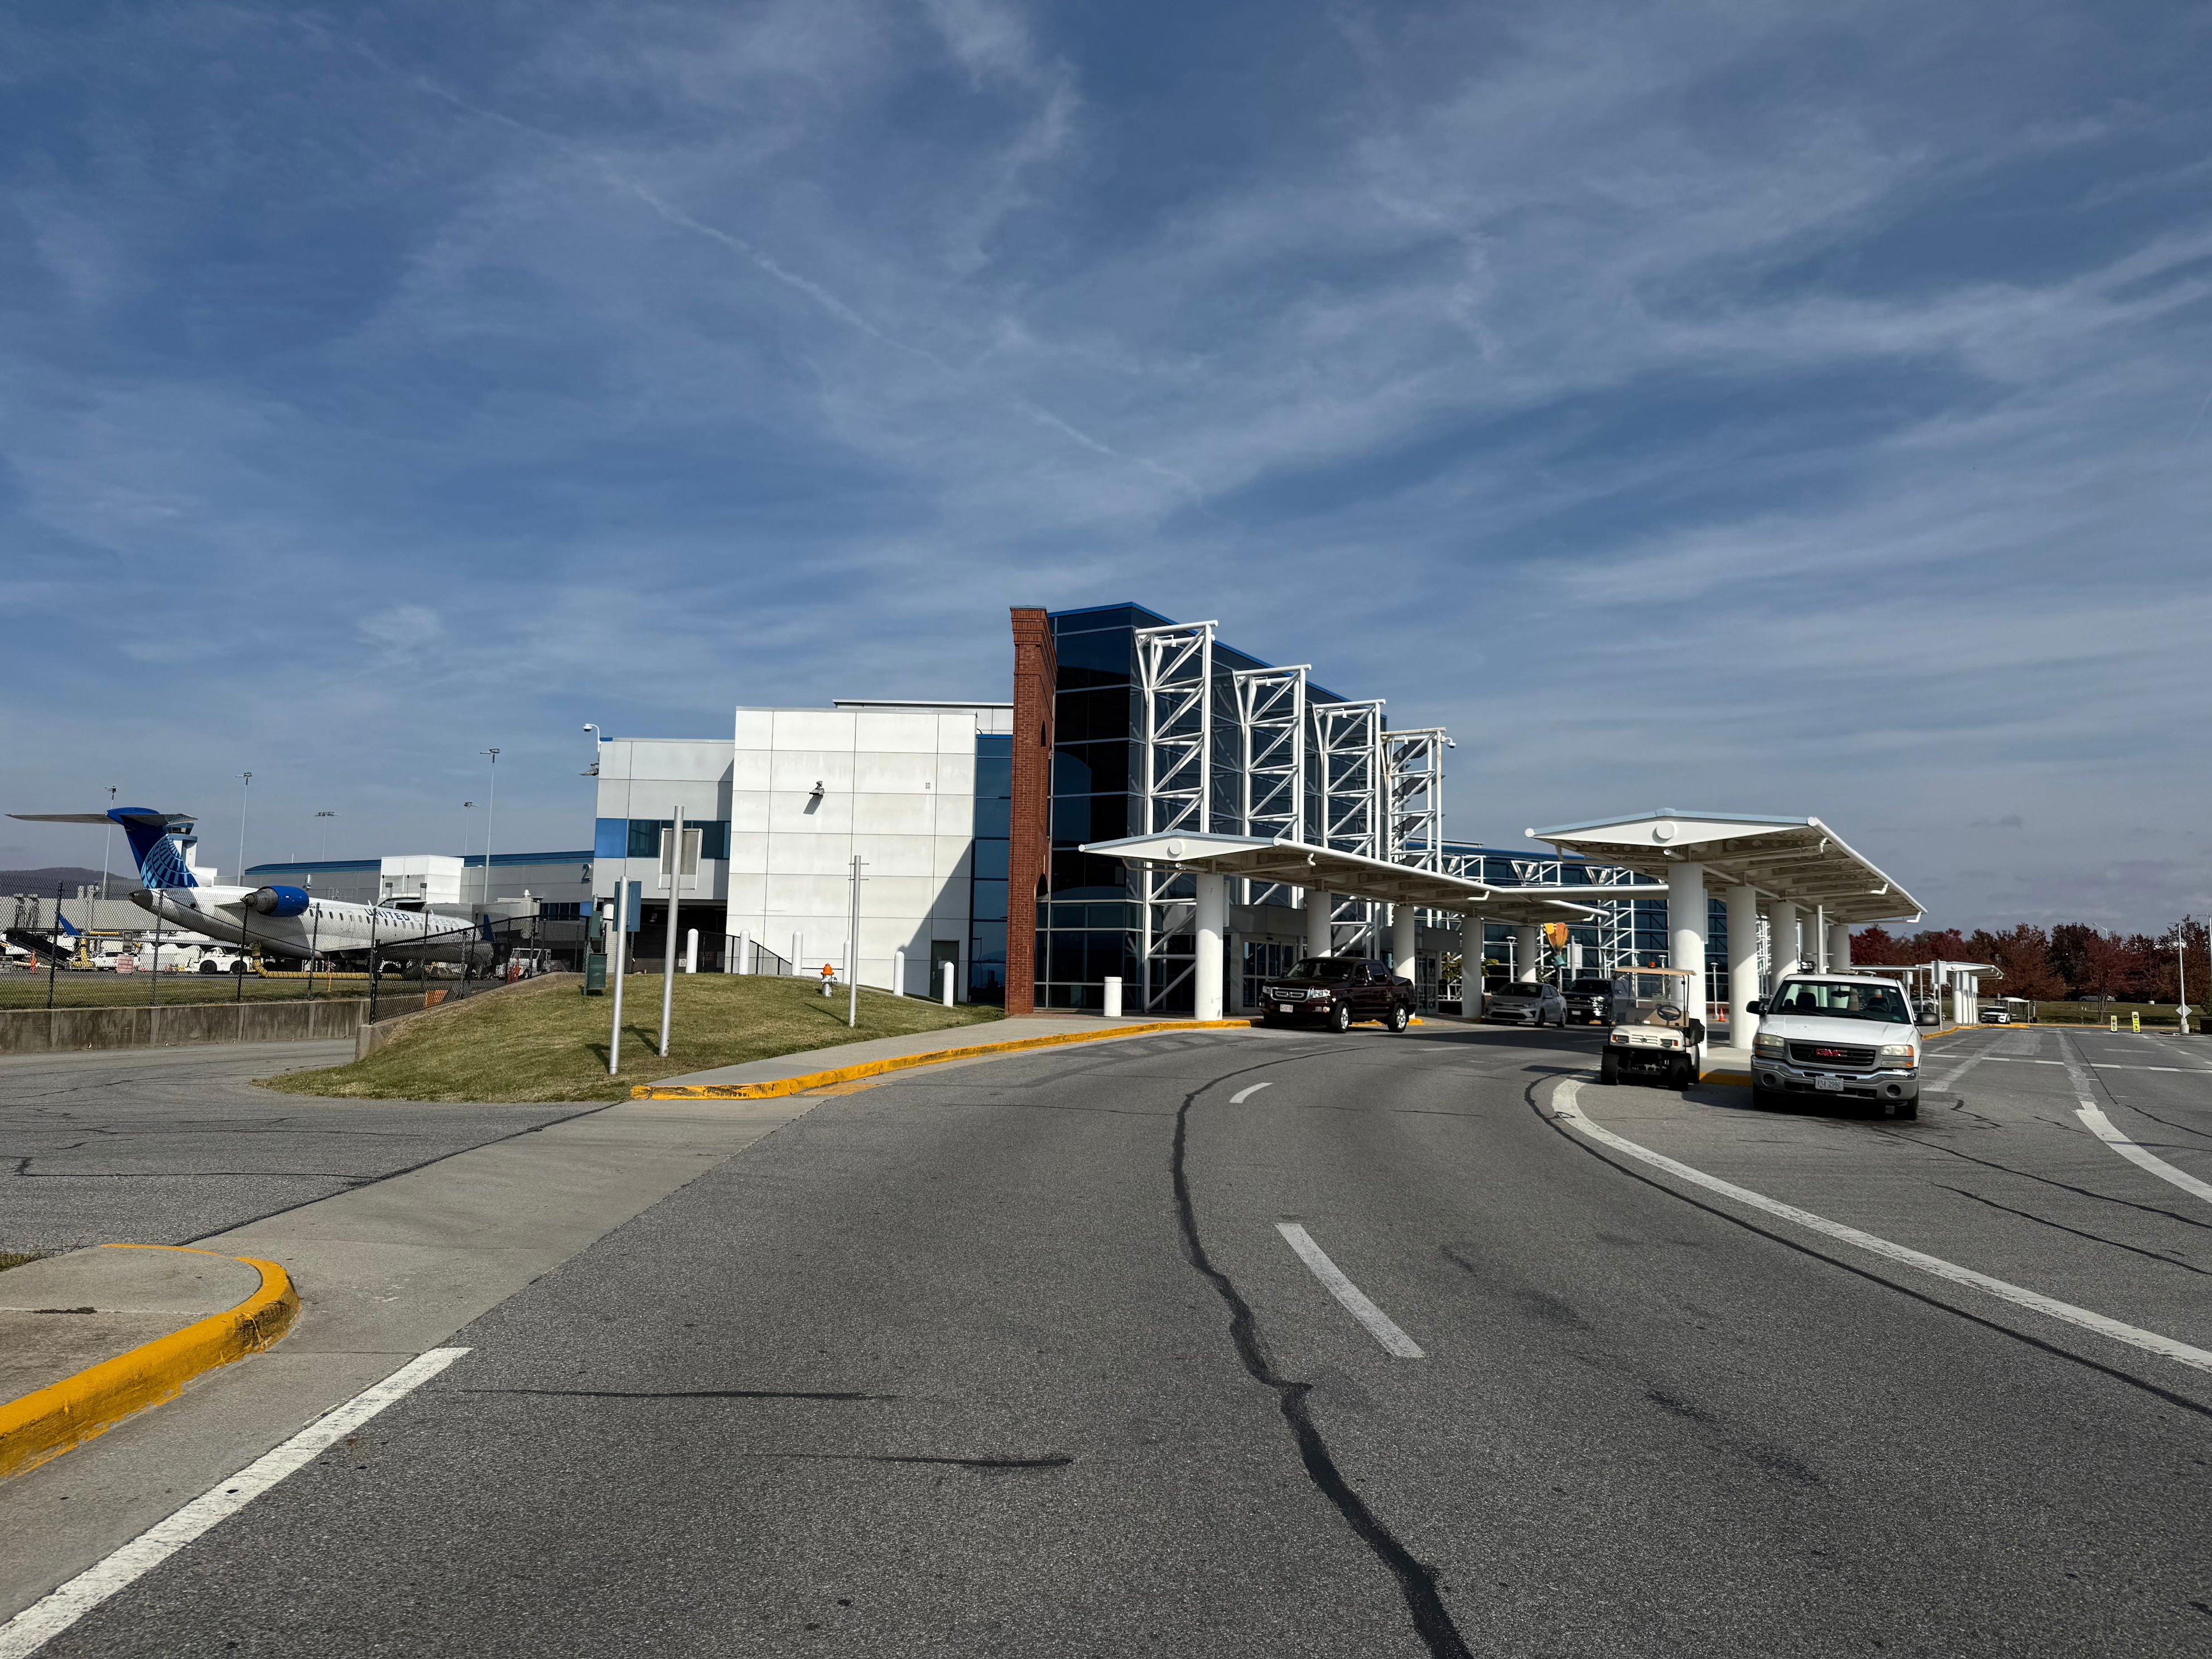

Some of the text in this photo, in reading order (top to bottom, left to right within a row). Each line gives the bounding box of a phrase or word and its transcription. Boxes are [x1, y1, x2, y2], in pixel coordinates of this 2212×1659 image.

[581, 864, 591, 884] 2
[364, 908, 410, 921] UNITED
[1816, 1049, 1848, 1057] GMC
